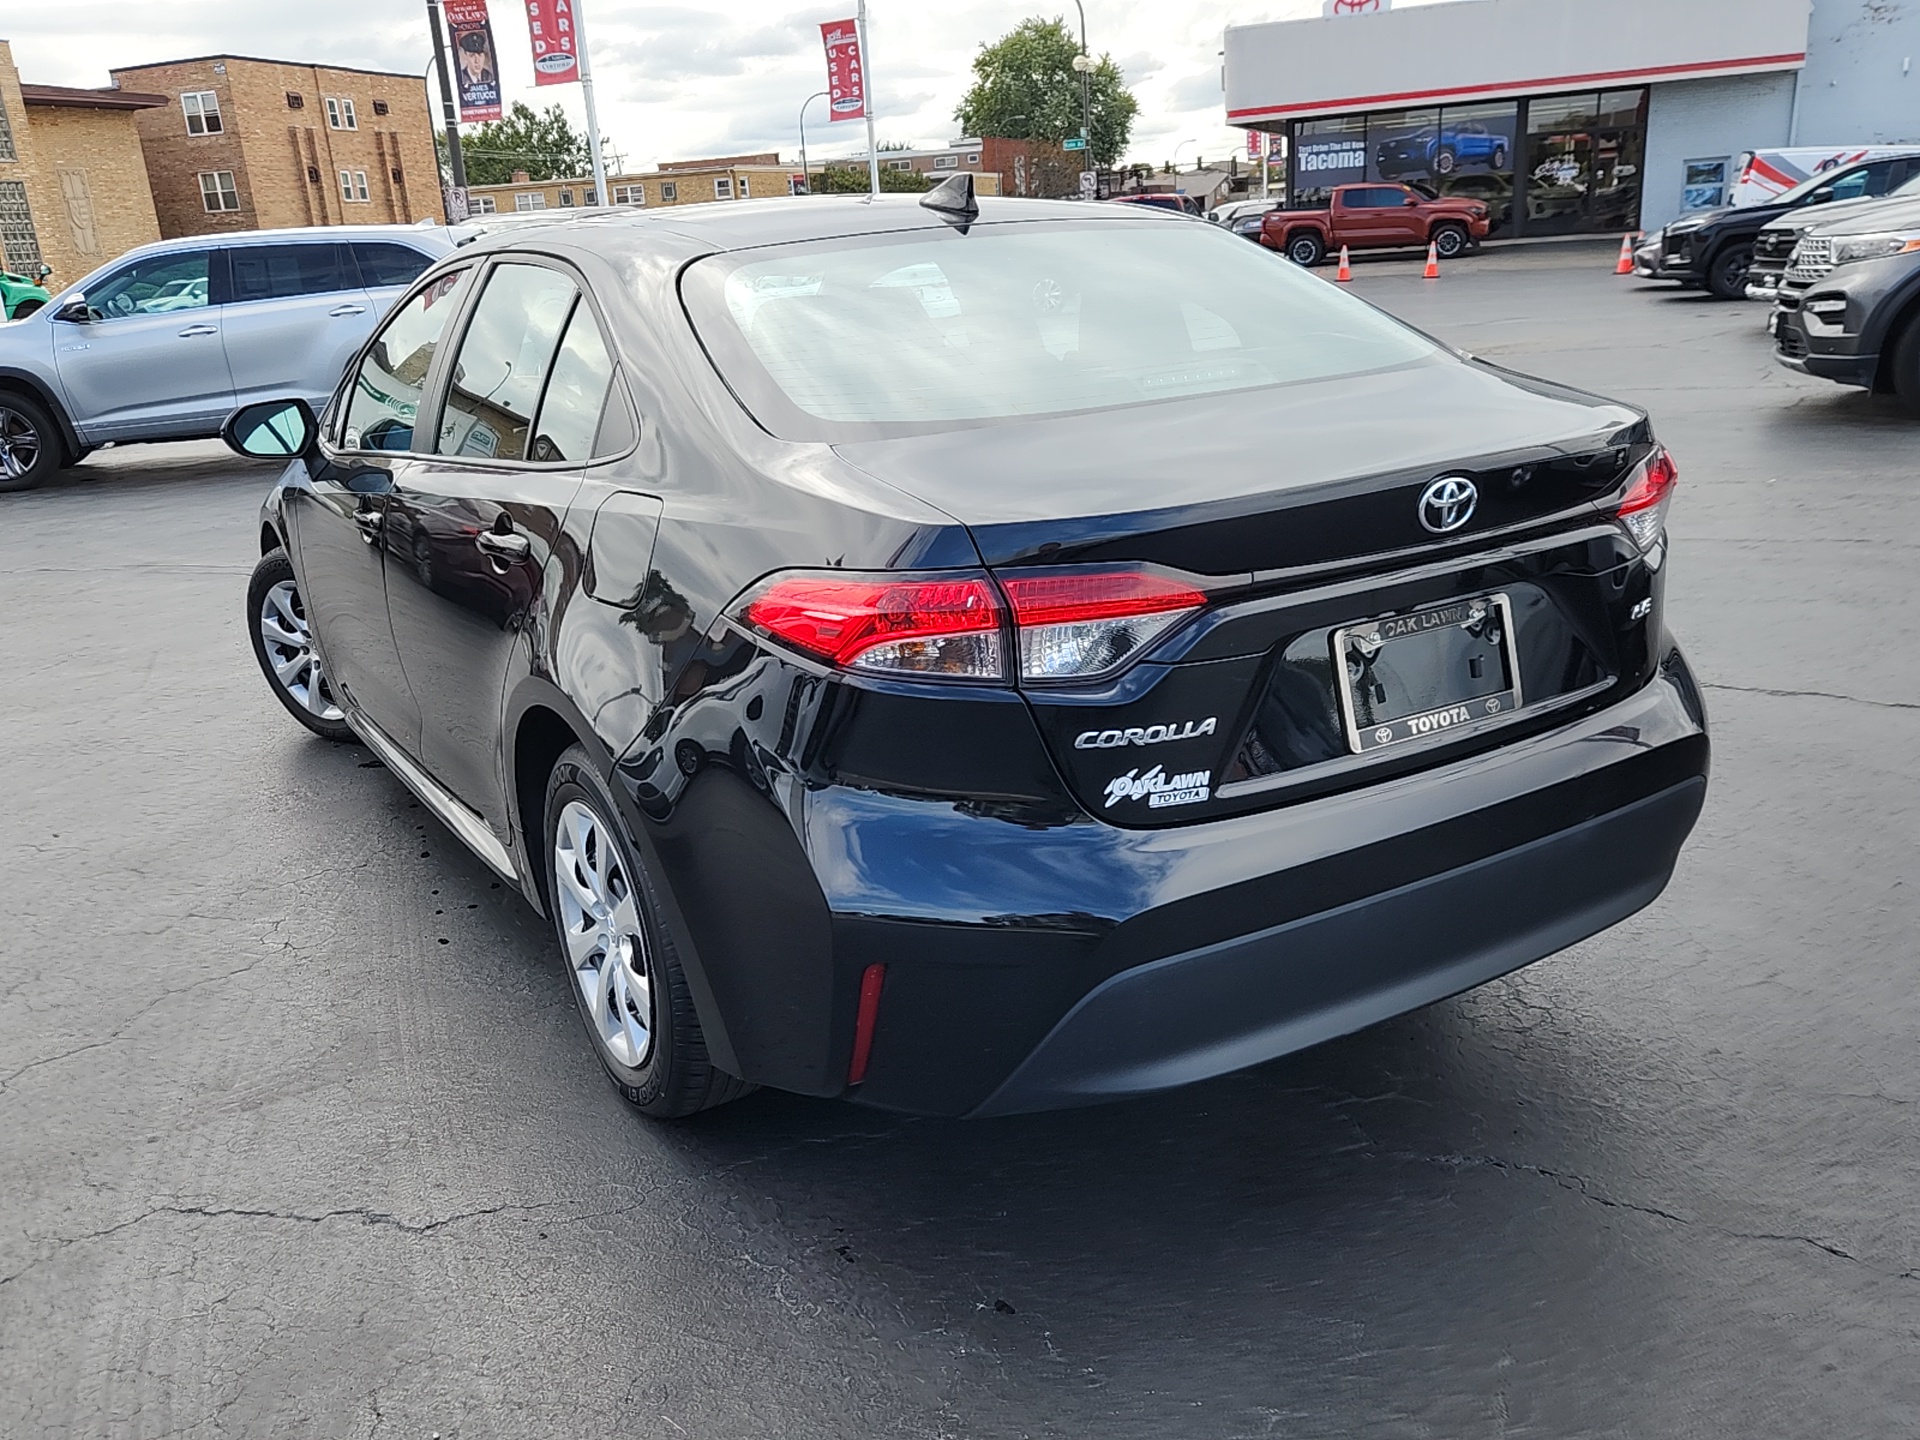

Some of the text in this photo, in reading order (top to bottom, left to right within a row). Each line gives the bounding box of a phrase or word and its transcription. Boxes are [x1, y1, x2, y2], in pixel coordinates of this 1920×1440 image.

[828, 48, 841, 99] USED
[848, 45, 860, 96] CARS
[1298, 150, 1365, 171] Tacoma
[1329, 142, 1342, 150] The
[1384, 606, 1463, 637] OAK LAWN
[1074, 716, 1218, 749] COROLLA
[1407, 706, 1471, 735] TOYOTA
[1156, 789, 1203, 805] TOYOTA
